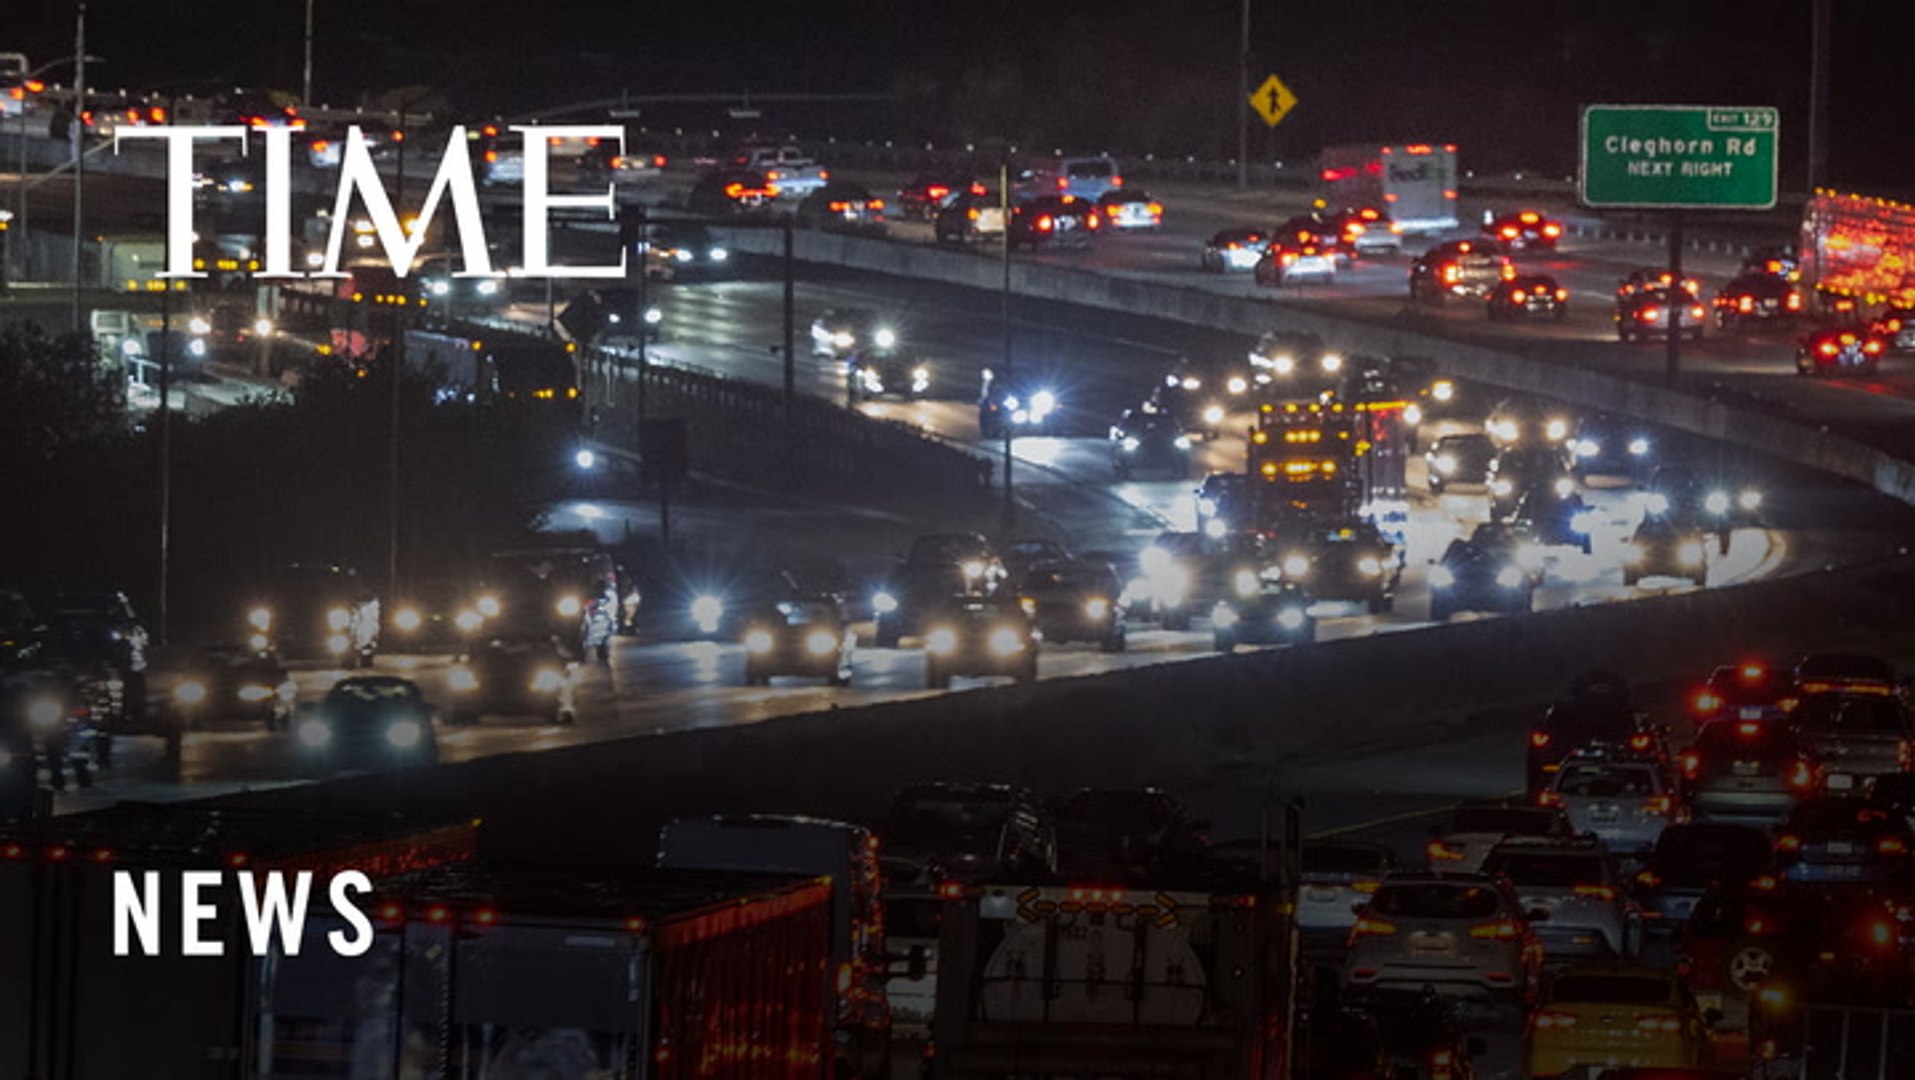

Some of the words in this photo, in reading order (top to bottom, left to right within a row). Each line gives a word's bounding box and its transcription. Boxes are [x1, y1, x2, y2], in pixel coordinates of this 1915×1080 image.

[1604, 135, 1714, 158] Cleghorn
[1725, 137, 1757, 156] Rd
[1627, 160, 1674, 177] NEXT
[1680, 161, 1734, 178] RIGHT
